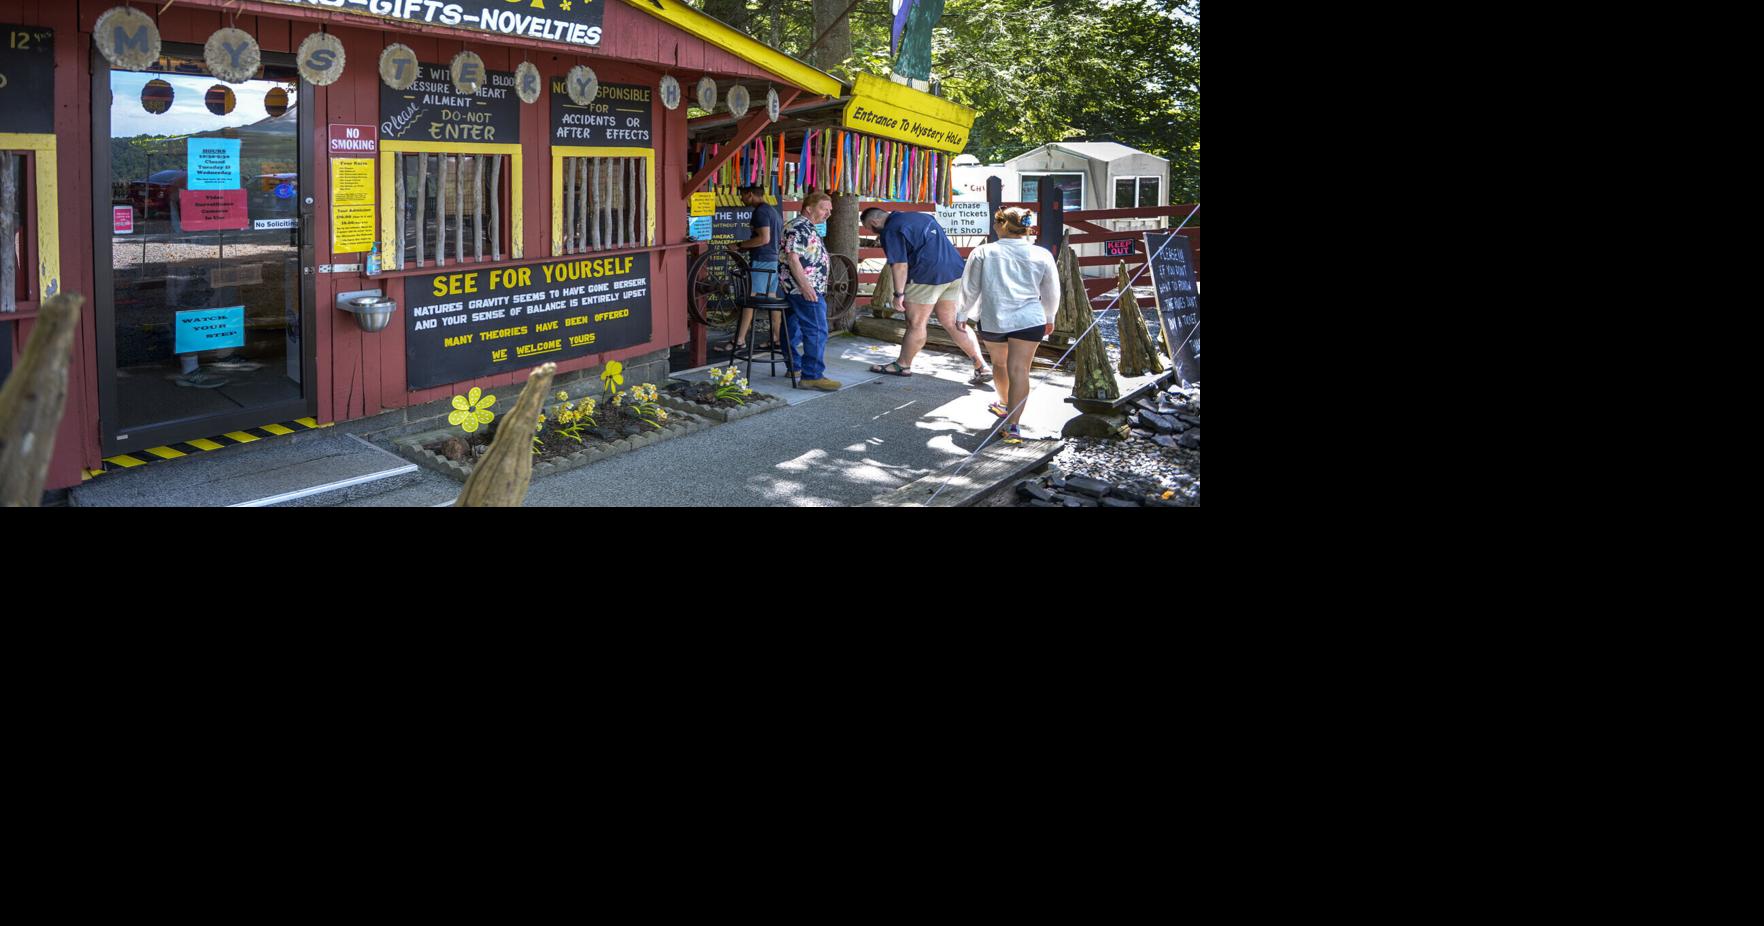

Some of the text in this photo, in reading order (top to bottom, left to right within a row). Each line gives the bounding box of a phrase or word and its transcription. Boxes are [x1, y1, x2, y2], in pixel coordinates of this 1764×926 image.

[10, 31, 31, 49] 12
[430, 68, 450, 81] WIT
[492, 75, 516, 87] BLOO
[406, 81, 450, 94] RESSURE
[552, 81, 650, 102] NO SPONSIBLE
[422, 94, 472, 107] AILMENT
[590, 103, 608, 113] FOR
[381, 102, 420, 137] Please
[441, 109, 492, 123] DO-NOT
[562, 113, 640, 127] ACCIDENTS OR
[853, 106, 898, 128] Entrance
[899, 118, 910, 131] To
[911, 122, 944, 142] Mystery
[346, 128, 359, 138] NO
[428, 121, 496, 140] ENTER
[556, 126, 649, 140] AFTER EFFECTS
[331, 139, 375, 150] SMOKING
[1107, 239, 1132, 249] KEEP
[1112, 247, 1129, 255] OUT
[433, 256, 634, 297] SEE FOR YOURSELF
[413, 278, 647, 317] NATURES GRAVITY SEEMS TO HAVE GONE BERSERK
[414, 288, 647, 331] AND YOUR SENSE OF BALANCE IS ENTIRELY UPSET
[206, 331, 237, 339] STEP
[444, 309, 629, 347] MANY THEORIES HAVE BEEN OFFERED
[492, 333, 596, 361] WE WELCOME YOURS
